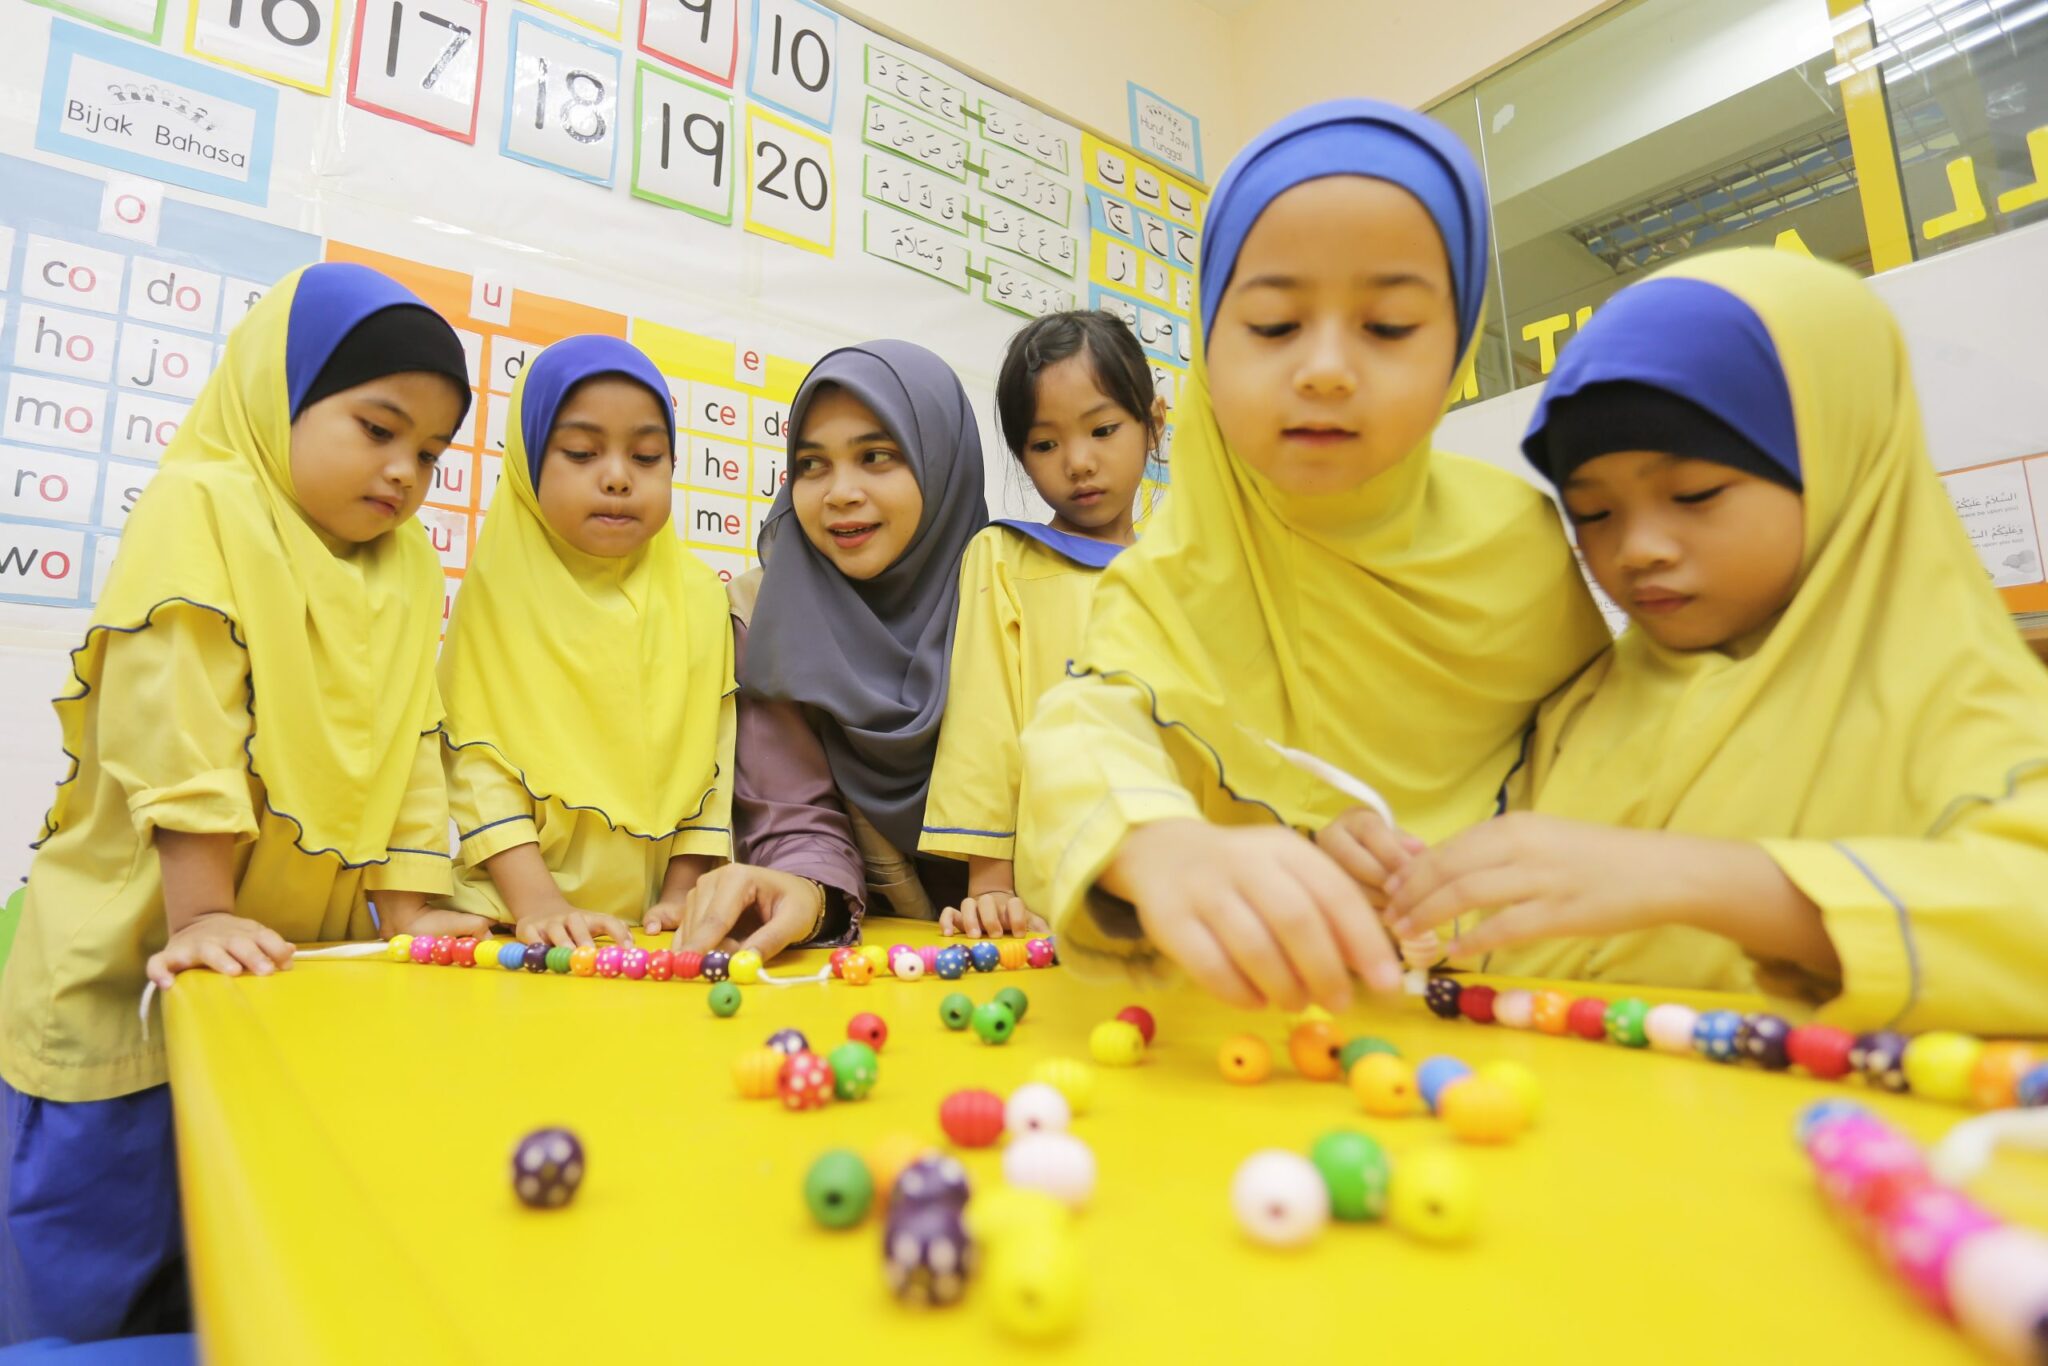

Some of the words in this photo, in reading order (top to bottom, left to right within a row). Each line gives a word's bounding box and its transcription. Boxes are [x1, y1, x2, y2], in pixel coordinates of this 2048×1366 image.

[386, 0, 471, 89] 17
[772, 14, 830, 92] 10
[535, 57, 607, 143] 18
[67, 99, 133, 136] Bijak
[155, 125, 245, 168] Bahasa
[661, 102, 724, 187] 19
[756, 140, 828, 211] 20
[115, 195, 146, 224] o
[43, 261, 96, 292] co
[147, 273, 201, 311] do
[484, 283, 502, 307] u
[35, 316, 93, 361] ho
[131, 339, 188, 386] jo
[505, 351, 524, 378] d
[744, 351, 759, 370] e
[15, 396, 93, 433] mo
[705, 403, 736, 425] ce
[127, 415, 176, 446] no
[705, 448, 739, 480] he
[14, 470, 68, 502] ro
[697, 510, 740, 534] me
[0, 547, 70, 579] wo
